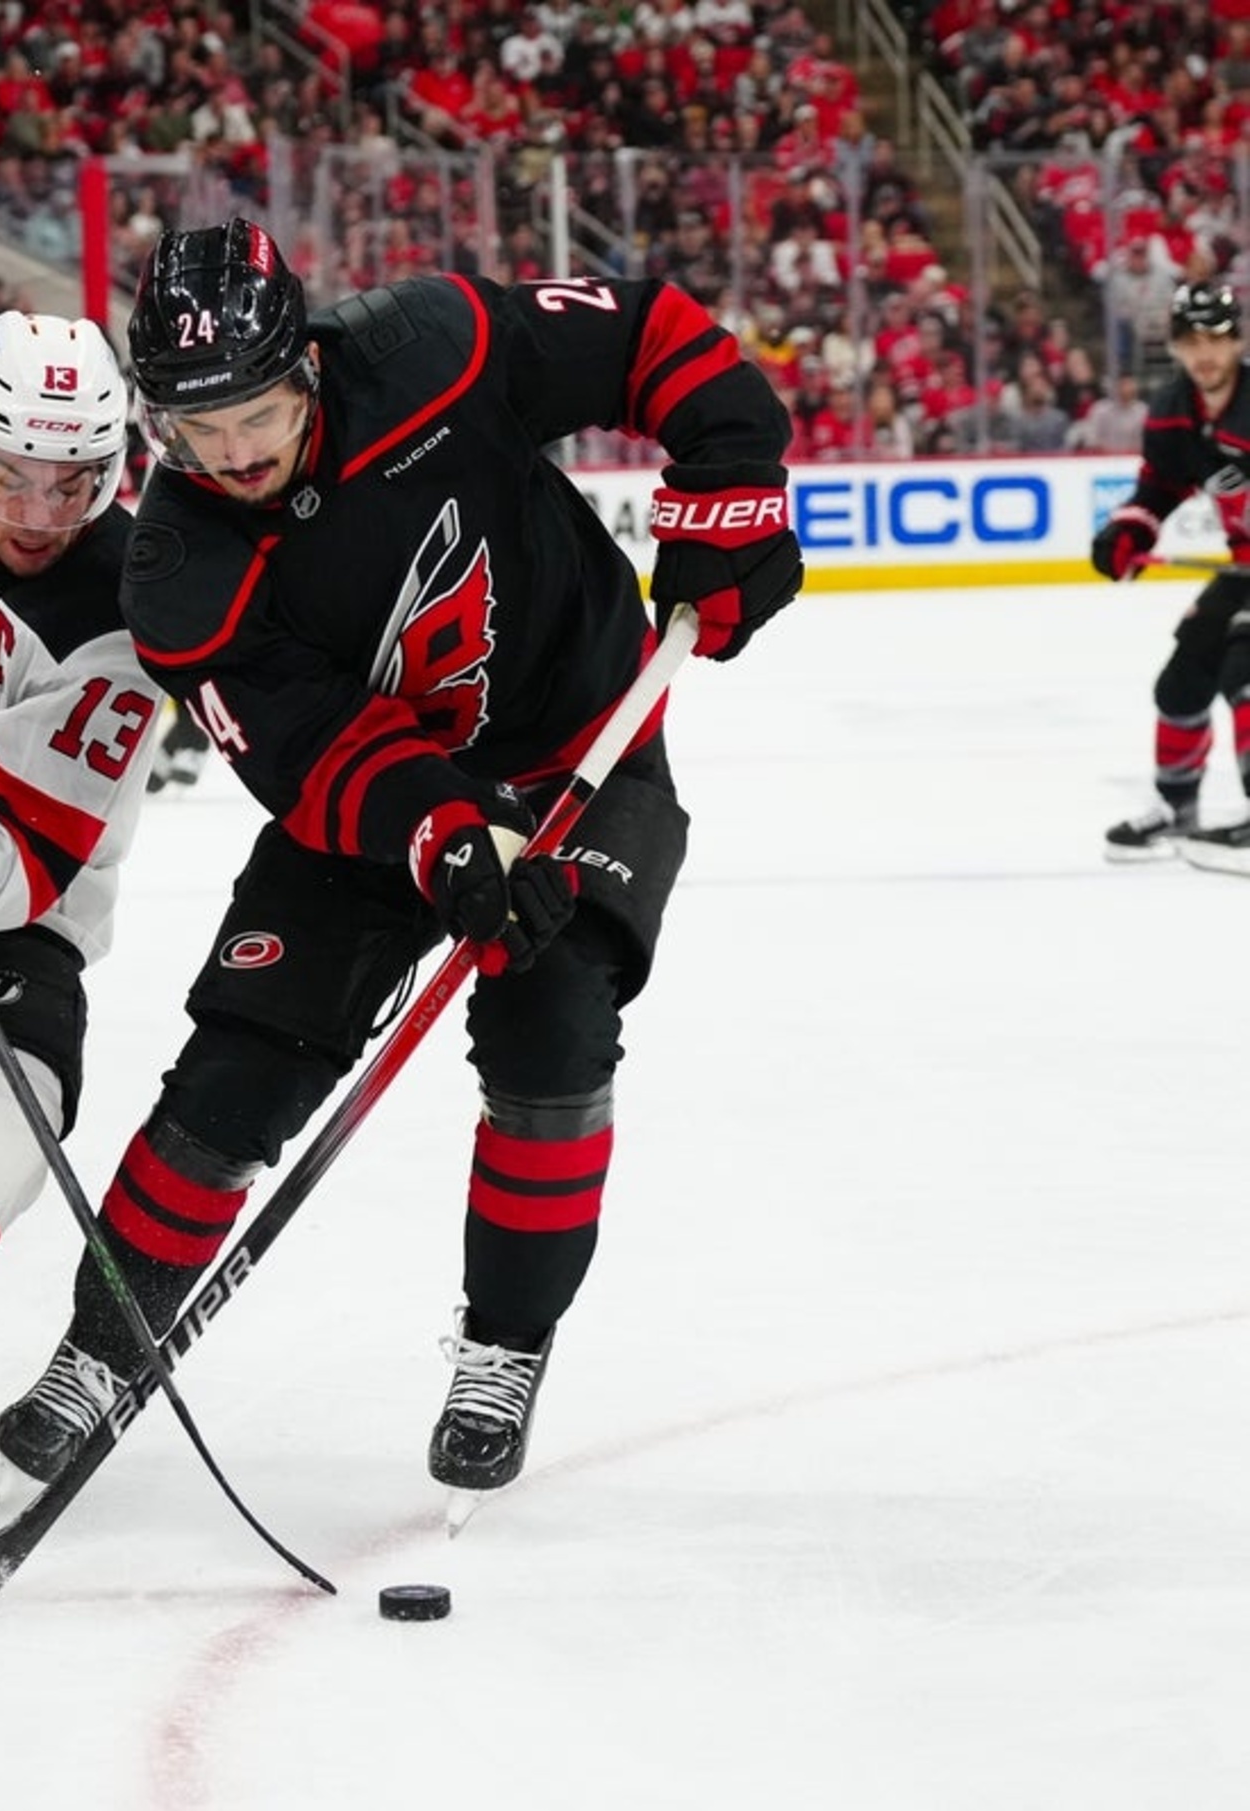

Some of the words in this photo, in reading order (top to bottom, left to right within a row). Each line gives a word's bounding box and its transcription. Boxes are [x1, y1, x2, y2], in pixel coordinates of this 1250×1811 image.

[177, 310, 214, 348] 24
[43, 366, 79, 392] 13
[176, 371, 233, 392] BAUER
[25, 418, 83, 433] CCM
[383, 426, 451, 480] NUCOR
[796, 476, 1052, 549] EICO
[49, 676, 157, 783] 13
